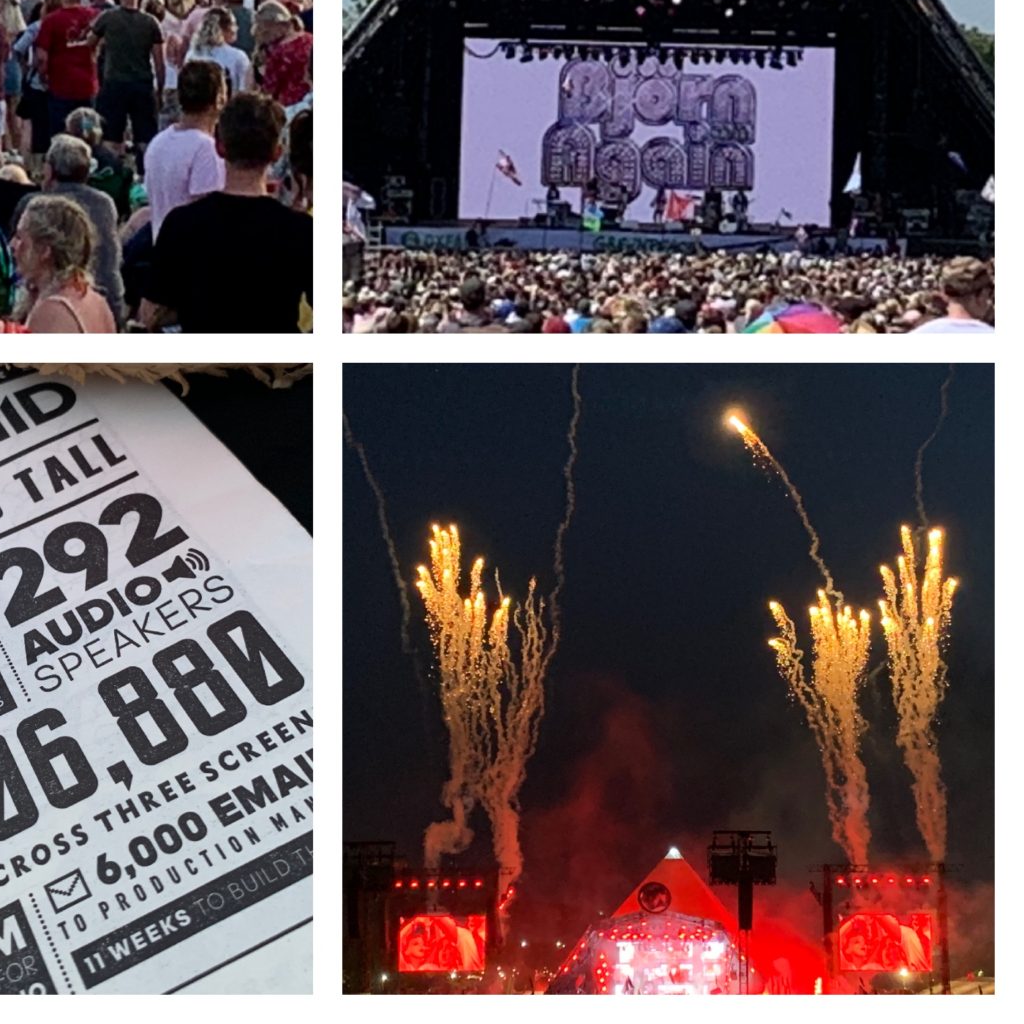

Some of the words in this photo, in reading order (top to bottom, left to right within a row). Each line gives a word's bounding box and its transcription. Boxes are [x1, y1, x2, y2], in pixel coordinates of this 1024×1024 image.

[12, 433, 128, 504] TALL
[23, 575, 163, 667] AUDIO
[34, 575, 234, 693] SPEAKERS
[93, 772, 197, 832] THREE
[57, 912, 88, 941] TO
[98, 826, 262, 920] PRODUCTION
[96, 811, 209, 886] 6,000
[83, 951, 107, 975] 11
[108, 908, 193, 962] WEEKS
[193, 891, 226, 917] TO
[228, 857, 292, 900] BUILD
